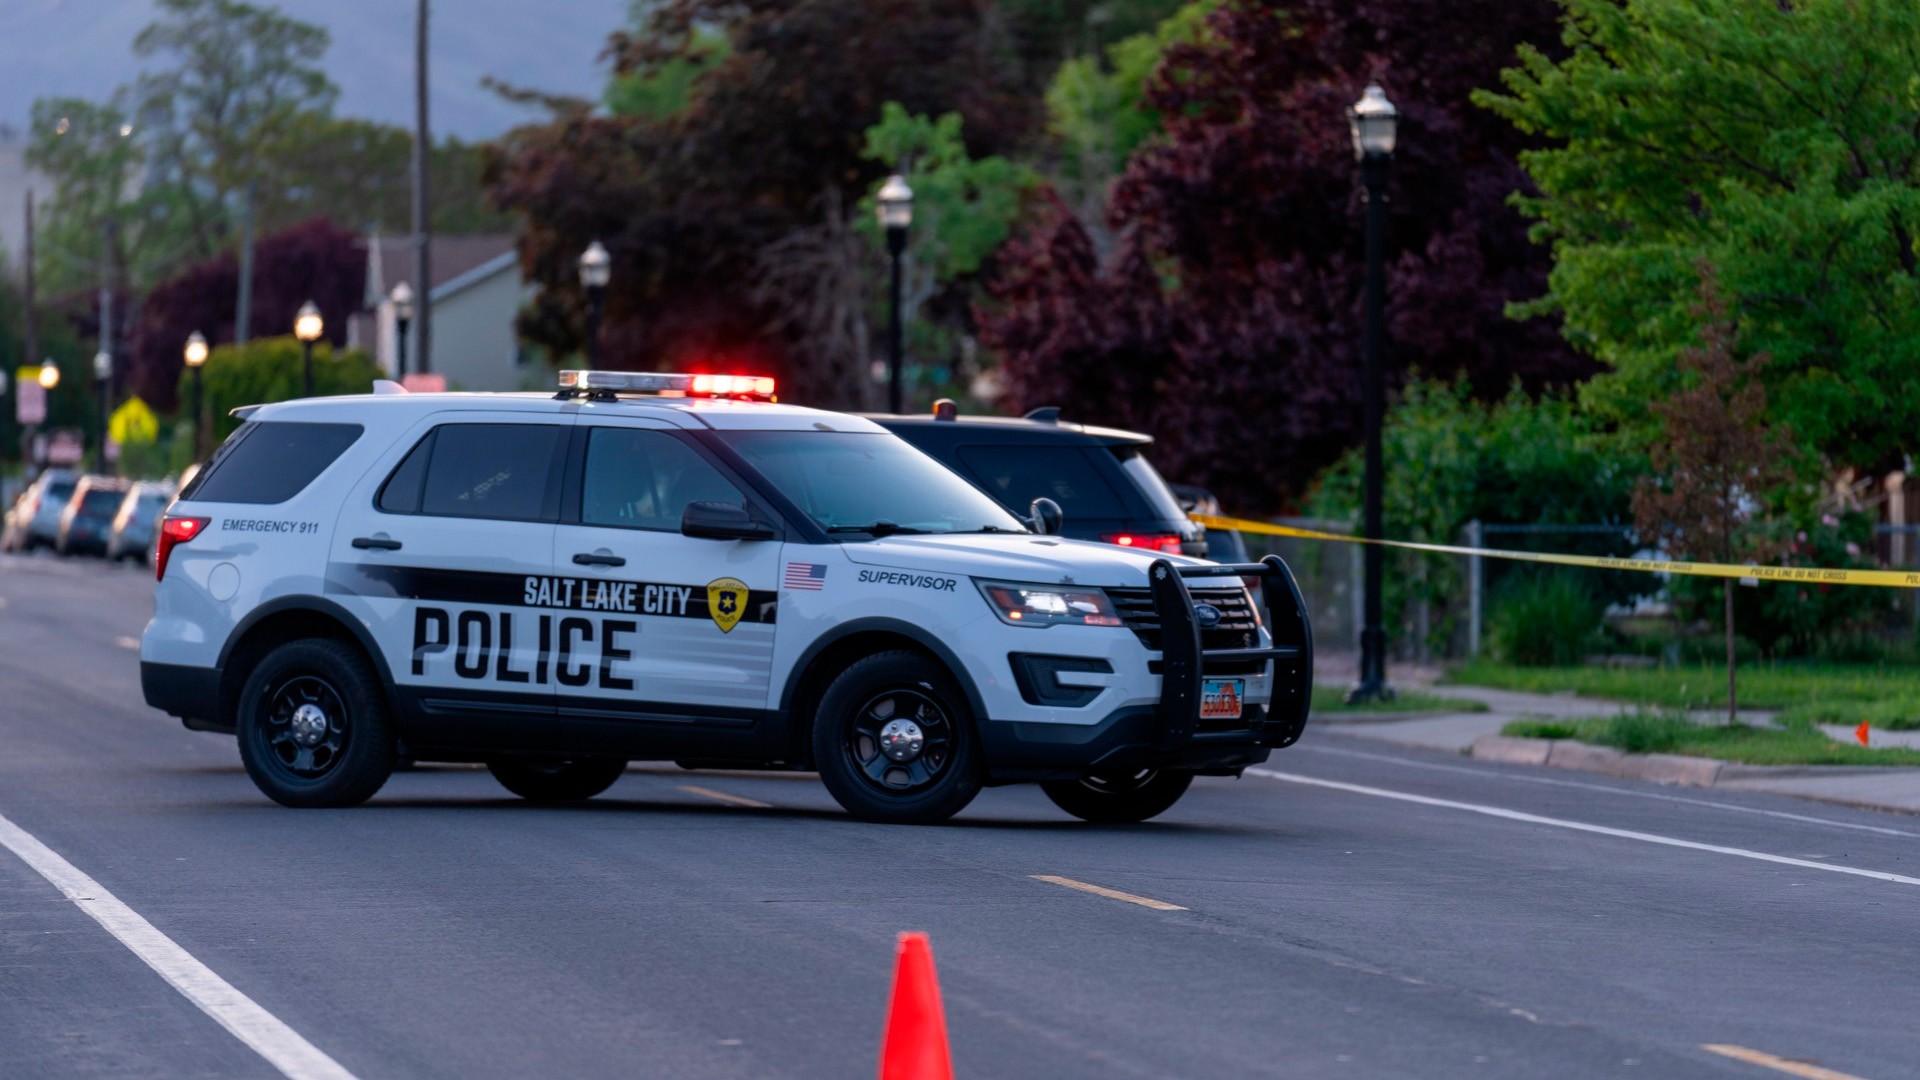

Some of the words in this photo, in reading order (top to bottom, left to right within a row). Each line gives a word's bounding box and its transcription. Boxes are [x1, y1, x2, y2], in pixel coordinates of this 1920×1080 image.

[222, 519, 297, 533] EMERGENCY
[299, 522, 319, 534] 911
[858, 569, 957, 592] SUPERVISOR
[1750, 567, 1774, 577] POLICE
[1778, 569, 1792, 577] LINE
[1795, 570, 1804, 578] DO
[1807, 571, 1820, 579] NOT
[1823, 572, 1847, 581] CROSS
[524, 576, 575, 607] SALT
[581, 580, 637, 611] LAKE
[643, 585, 691, 615] CITY
[412, 606, 637, 691] POLICE
